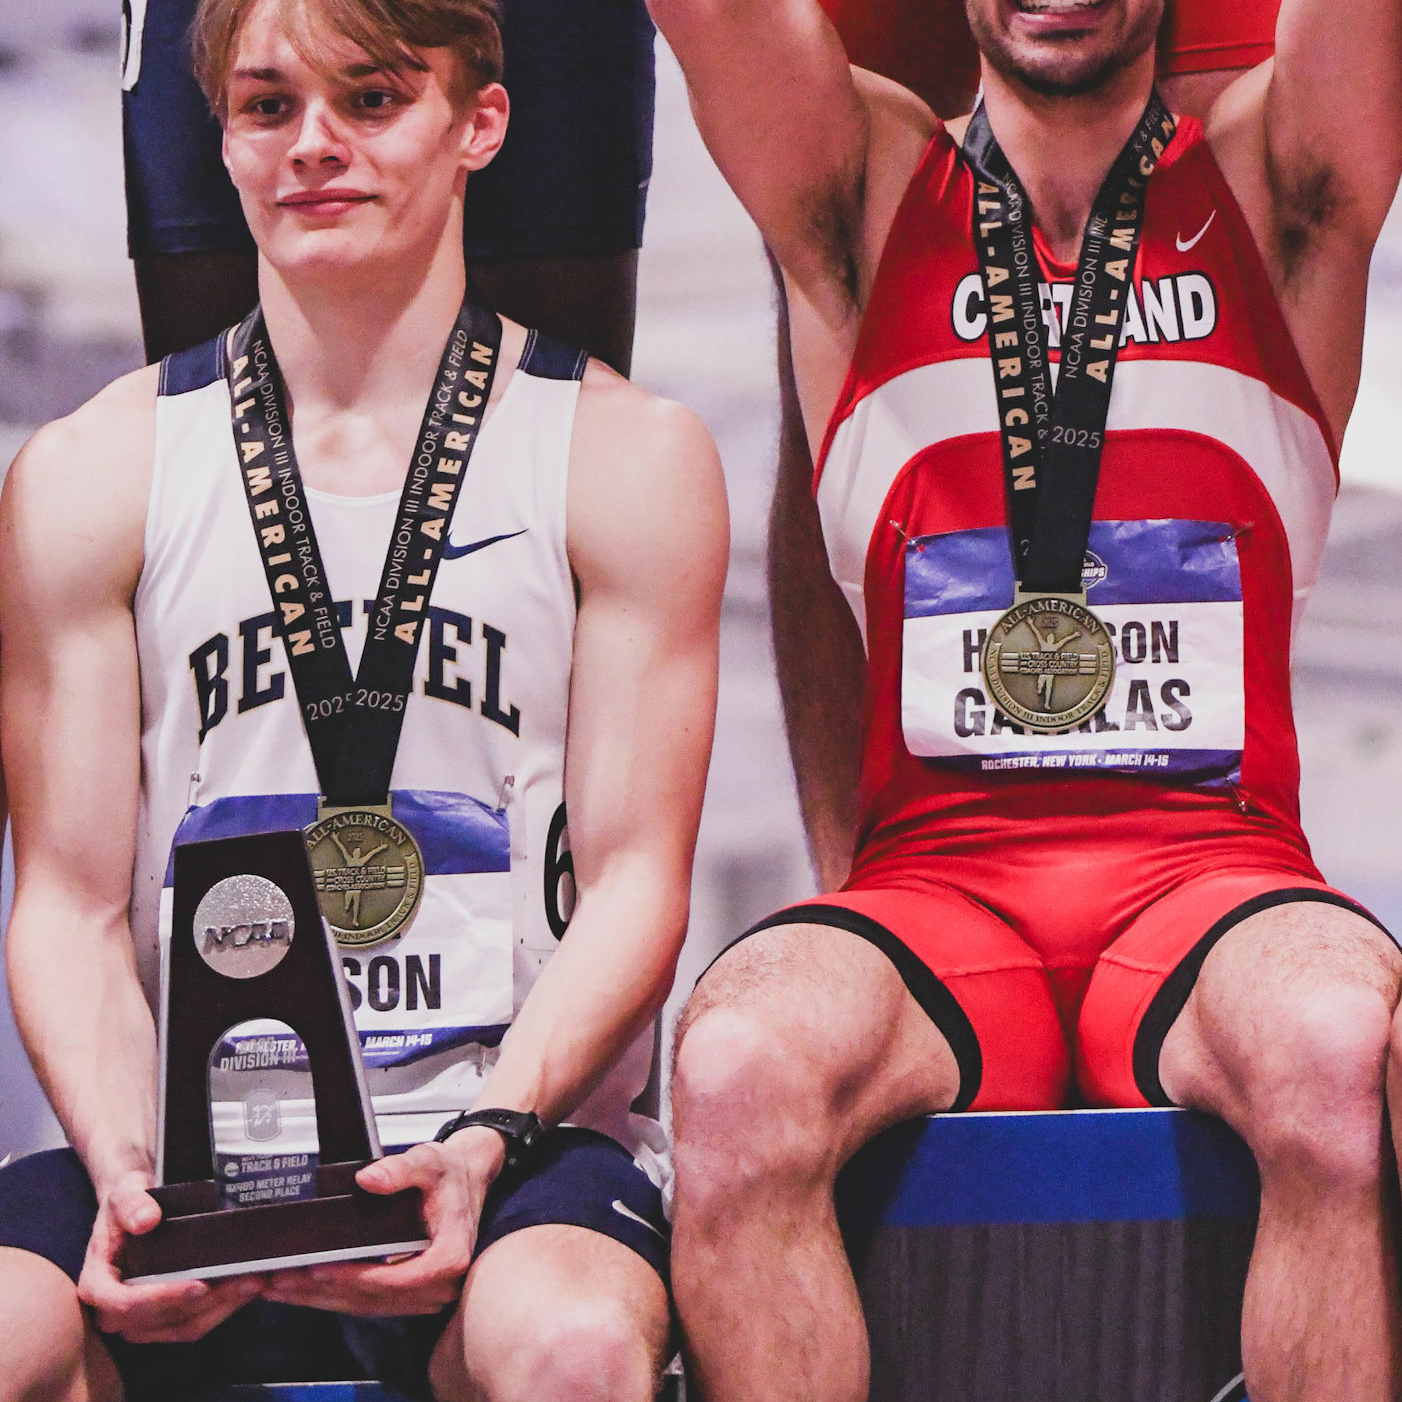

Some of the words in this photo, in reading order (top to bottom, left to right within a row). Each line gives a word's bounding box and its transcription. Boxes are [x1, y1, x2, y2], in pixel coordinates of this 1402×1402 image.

[1018, 278, 1032, 297] III
[1064, 332, 1084, 379] NCAA
[1074, 257, 1098, 329] DIVISION
[1088, 235, 1104, 253] III
[448, 329, 468, 368] FIELD
[977, 180, 1037, 493] ALL-AMERICAN
[1021, 301, 1042, 370] INDOOR
[252, 338, 269, 381] NCAA
[443, 369, 458, 381] &
[259, 382, 285, 449] DIVISION
[428, 381, 454, 427] TRACK
[1030, 371, 1049, 425] TRACK
[1051, 425, 1101, 450] 2025
[273, 450, 289, 466] III
[410, 431, 440, 496] INDOOR
[232, 353, 316, 657] ALL-AMERICAN
[277, 468, 306, 535] INDOOR
[394, 340, 495, 645] ALL-AMERICAN
[404, 497, 419, 513] III
[294, 535, 320, 587] TRACK
[386, 517, 413, 589] DIVISION
[309, 591, 324, 603] &
[1000, 598, 1101, 635] ALL-AMERICAN
[313, 605, 336, 649] FIELD
[373, 594, 396, 641] NCAA
[1048, 660, 1078, 668] COUNTRY
[1061, 652, 1079, 660] FIELD
[356, 688, 404, 713] 2025
[1035, 710, 1074, 724] INDOOR
[981, 757, 1040, 771] ROCHESTER,
[1041, 755, 1066, 768] NEW
[1067, 754, 1096, 768] YORK
[1104, 753, 1143, 766] MARCH
[1144, 752, 1169, 766] 14-15
[306, 812, 407, 851] ALL-AMERICAN
[365, 1036, 404, 1049] MARCH
[405, 1033, 432, 1046] 14-15
[220, 1051, 277, 1071] DIVISION
[241, 1157, 274, 1173] TRACK
[283, 1154, 308, 1168] FIELD
